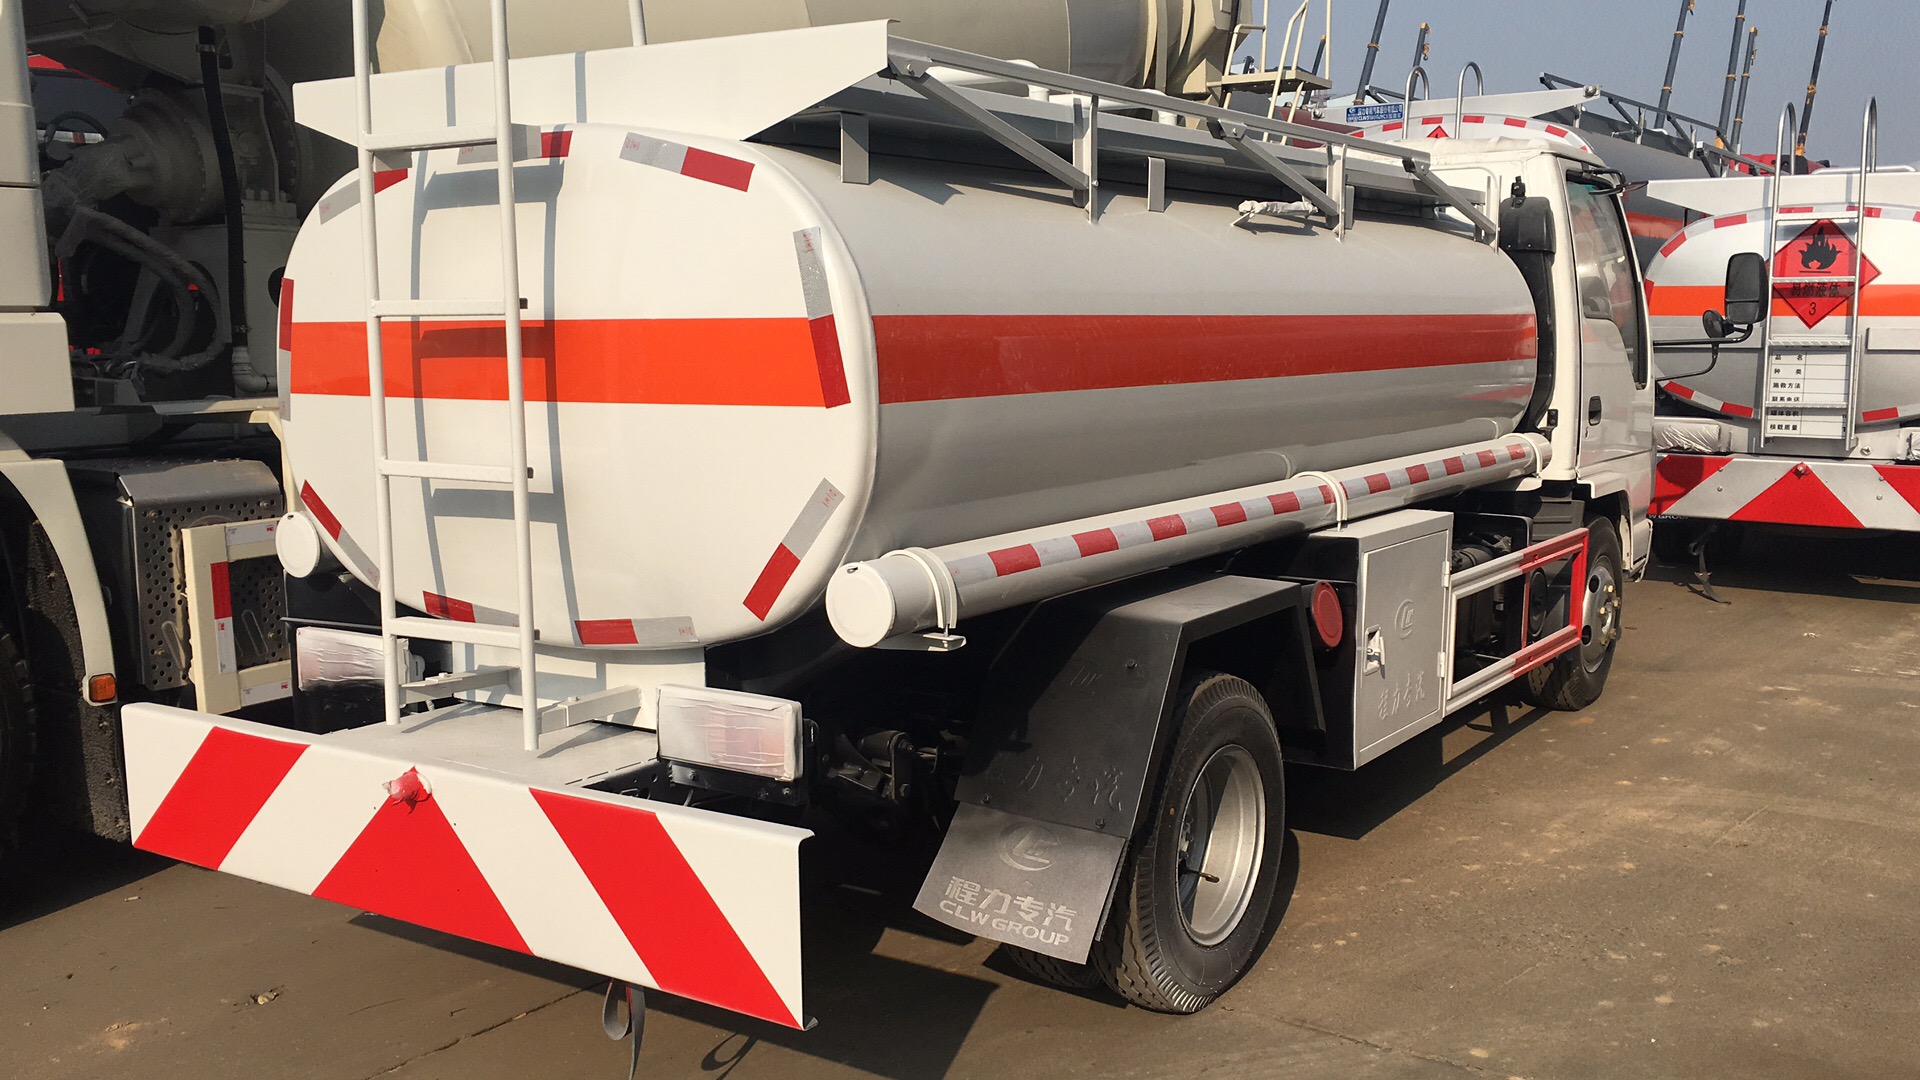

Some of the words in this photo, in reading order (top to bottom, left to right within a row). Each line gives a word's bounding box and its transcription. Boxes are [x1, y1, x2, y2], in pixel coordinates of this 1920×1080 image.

[1808, 301, 1817, 316] 3
[938, 900, 990, 926] CLW
[991, 918, 1070, 946] GROUP
[944, 875, 1078, 932] 程力专汽
